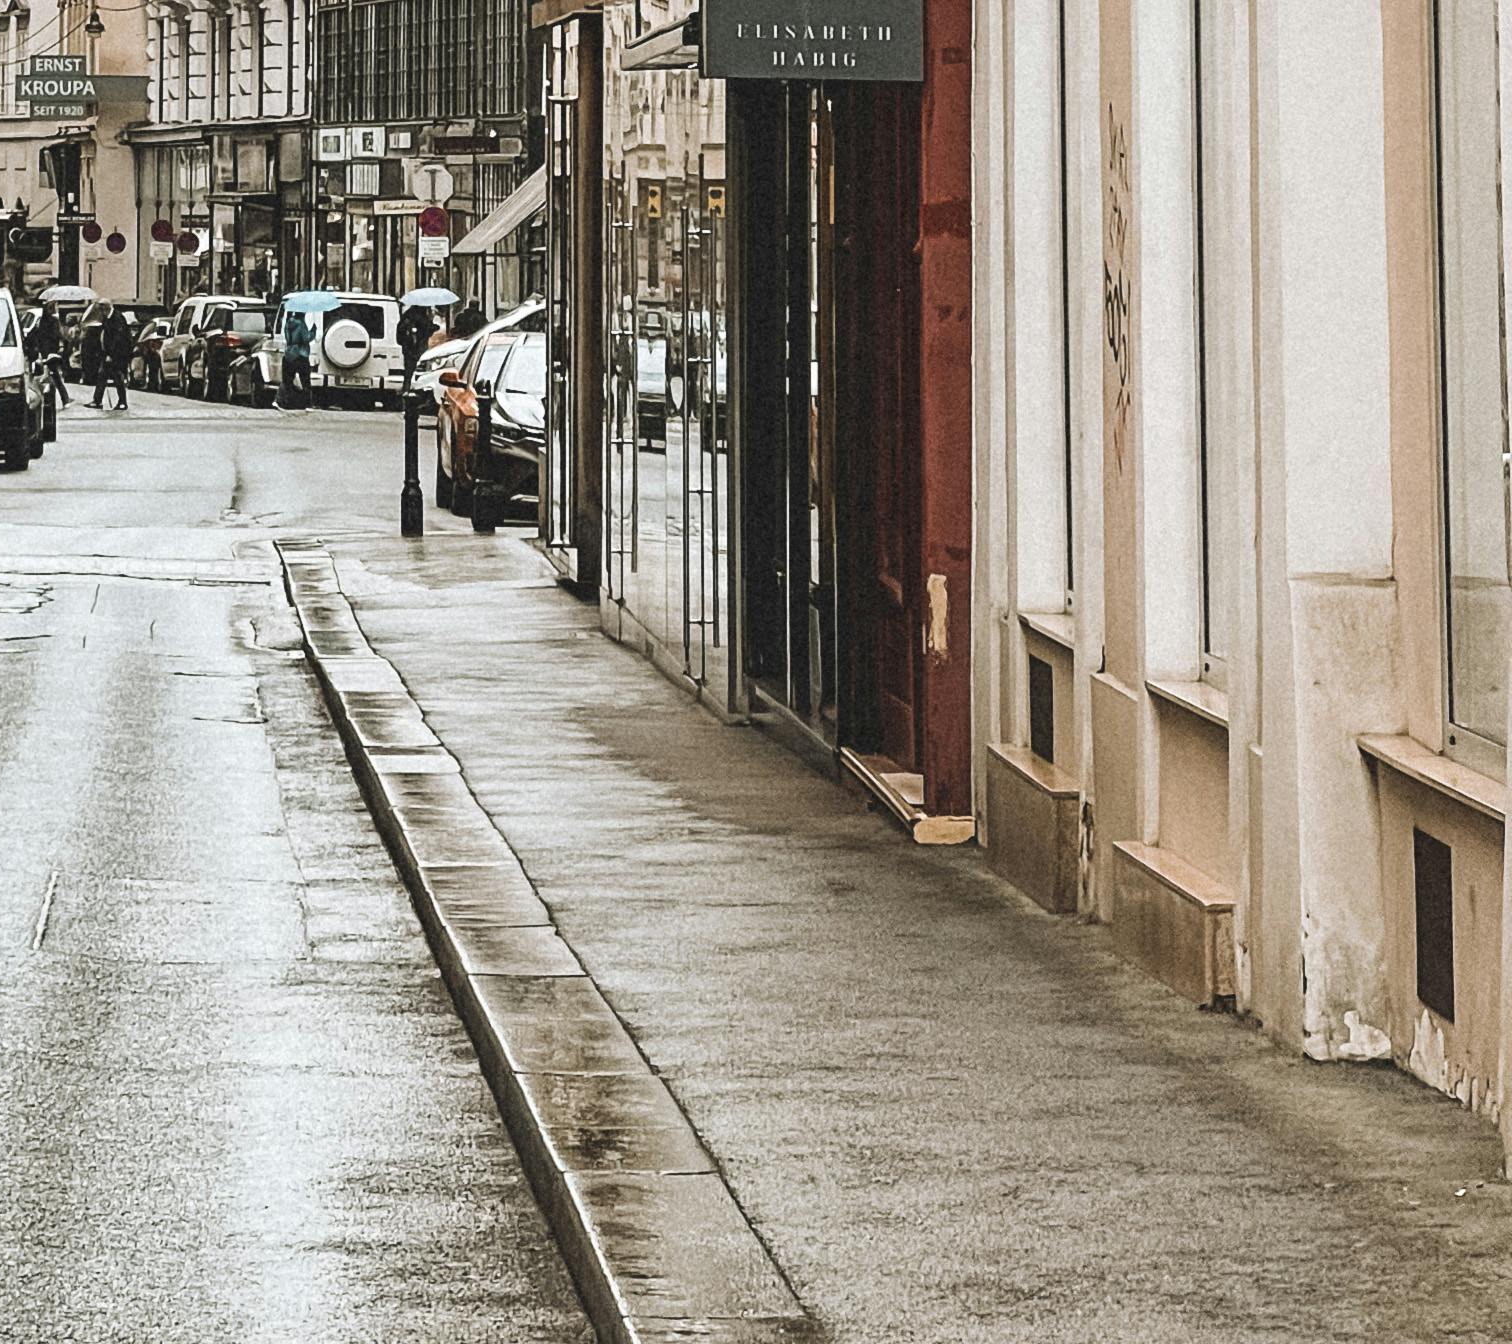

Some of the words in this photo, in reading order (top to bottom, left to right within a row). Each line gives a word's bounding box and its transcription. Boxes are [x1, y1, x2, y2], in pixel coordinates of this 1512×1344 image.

[737, 23, 892, 41] ELISABETH
[35, 58, 83, 72] ERNST
[773, 50, 856, 67] HABIG
[20, 80, 96, 96] KROUPA
[33, 105, 56, 117] SEIT
[58, 105, 84, 117] 1920
